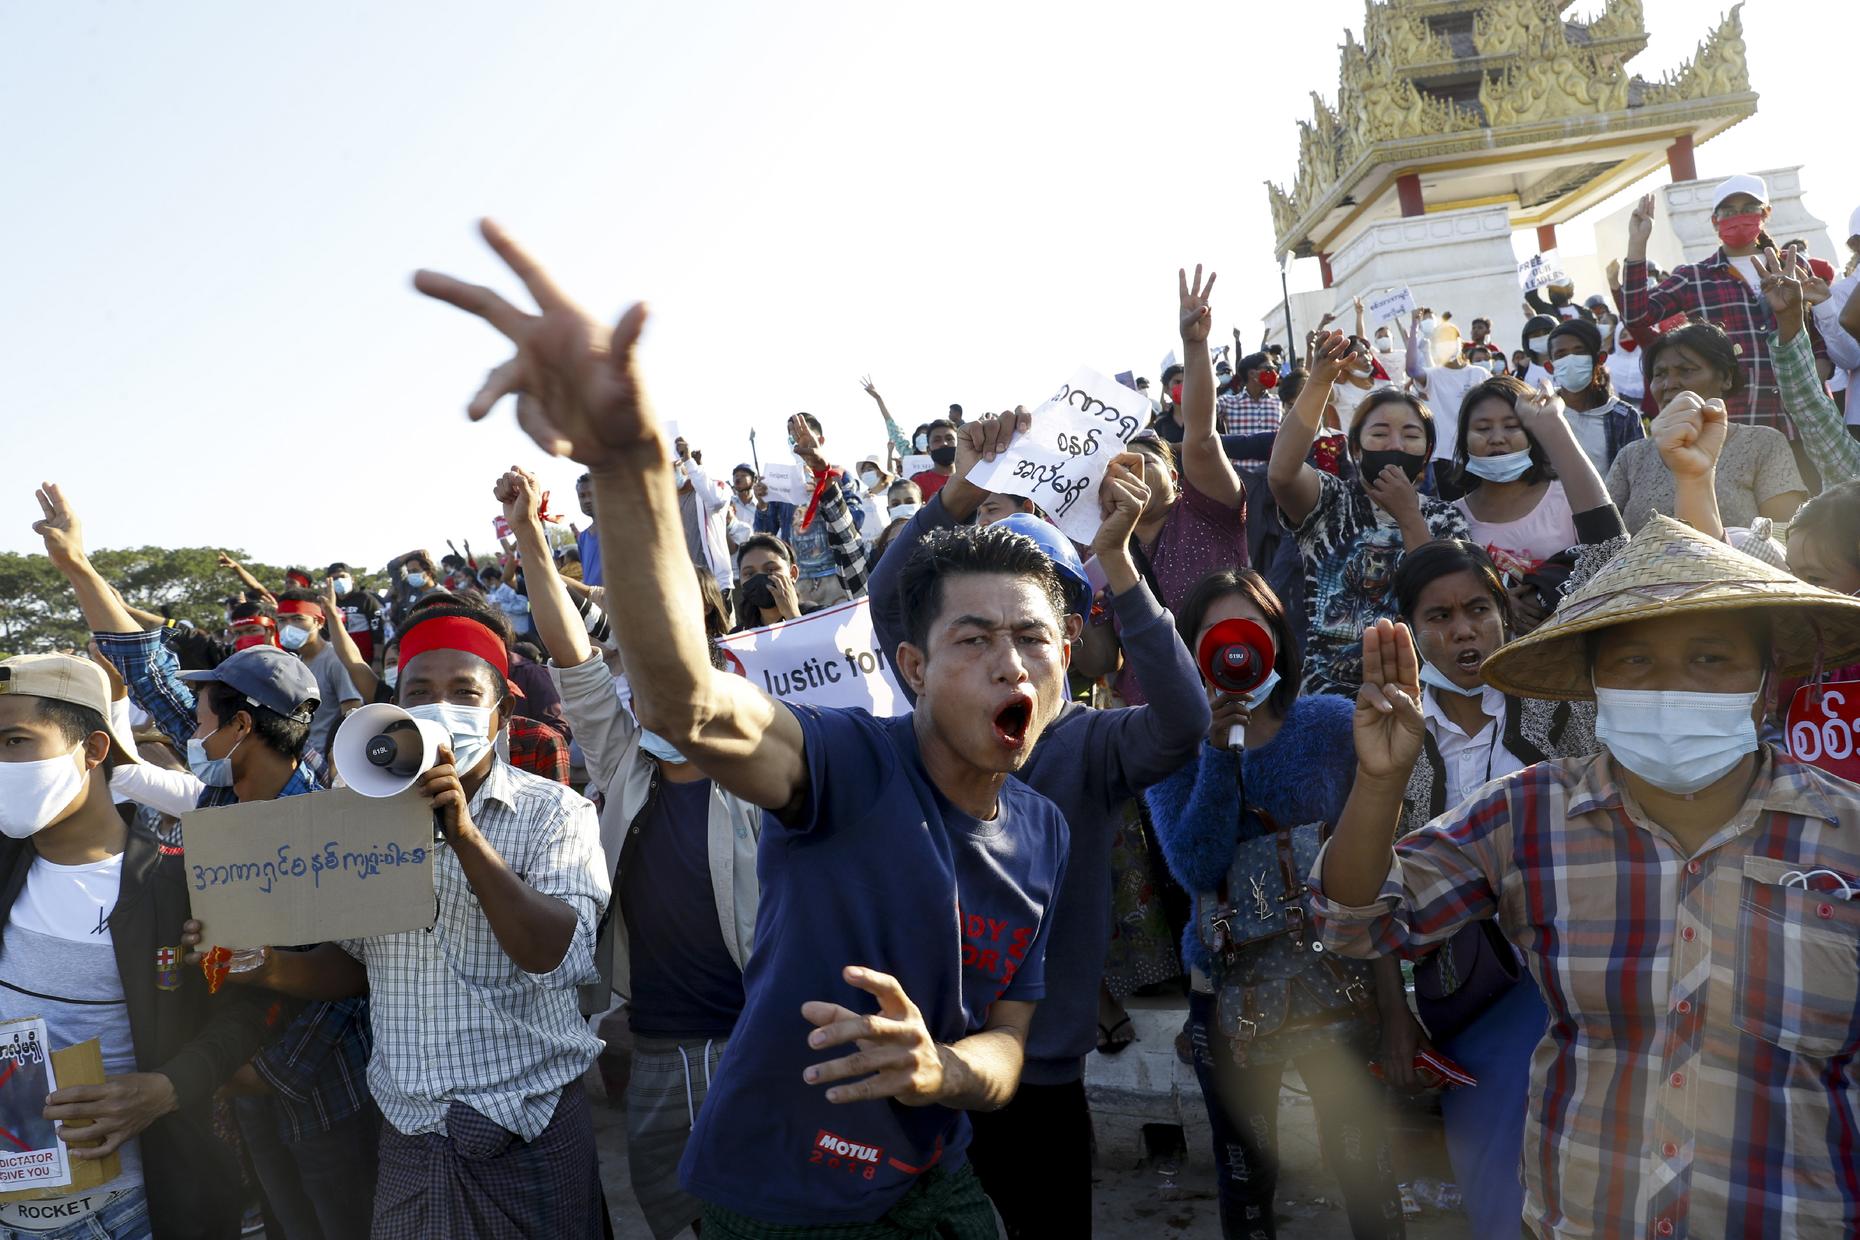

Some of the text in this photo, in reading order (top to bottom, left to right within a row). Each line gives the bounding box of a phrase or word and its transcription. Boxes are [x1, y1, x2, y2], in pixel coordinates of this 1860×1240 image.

[845, 648, 885, 678] for
[1792, 690, 1860, 762] စစ်
[0, 1152, 53, 1168] DICTATOR
[819, 1134, 879, 1163] MOTUL
[0, 1166, 50, 1181] GIVE YOU
[809, 1150, 876, 1180] 2018
[18, 1197, 91, 1219] ROCKET
